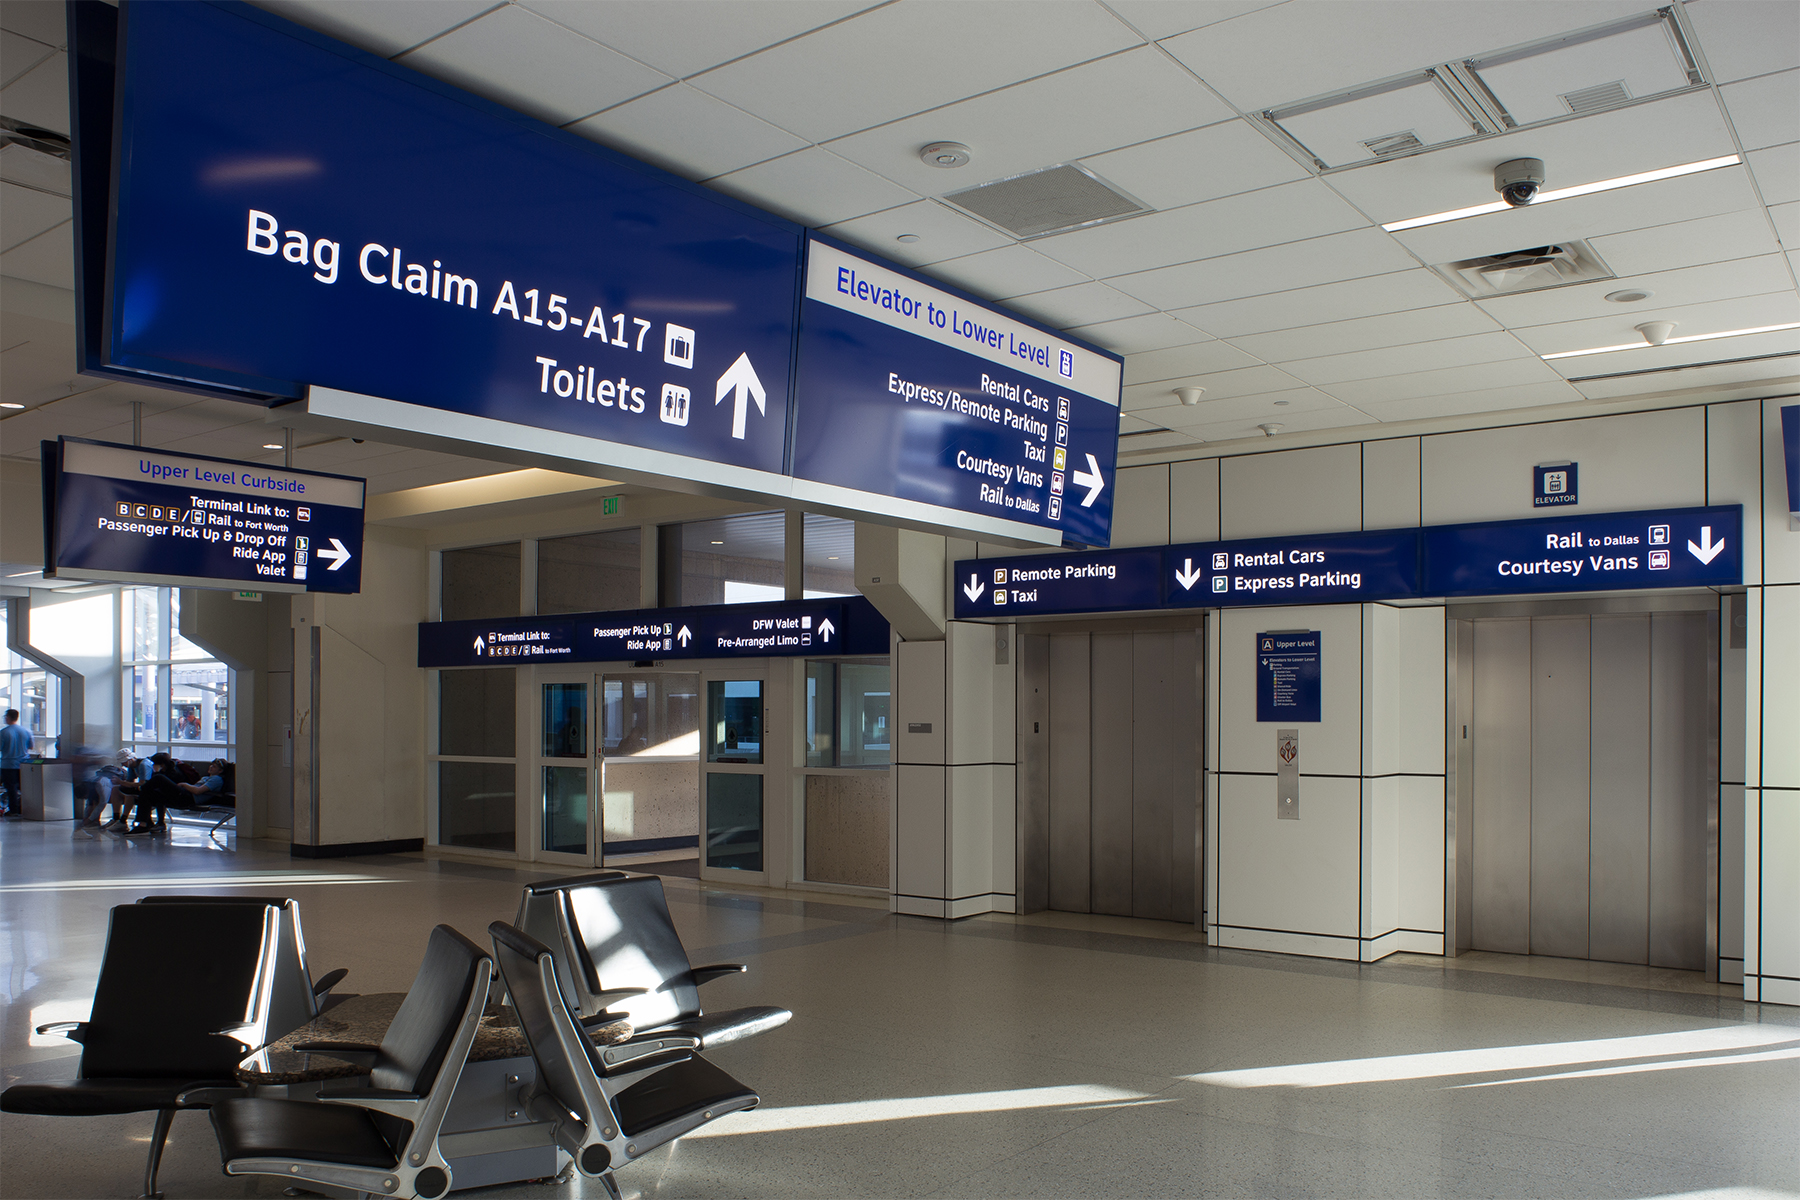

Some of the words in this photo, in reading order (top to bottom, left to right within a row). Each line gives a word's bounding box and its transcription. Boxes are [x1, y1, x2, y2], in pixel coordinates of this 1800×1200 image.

[246, 209, 341, 285] Bag
[359, 242, 479, 310] Claim
[491, 280, 652, 353] A15-A17
[837, 266, 921, 320] Elevator
[927, 302, 946, 328] to
[952, 310, 1004, 349] Lower
[1009, 332, 1050, 369] Level
[536, 355, 646, 414] Toilets
[981, 373, 1020, 403] Rental
[1023, 389, 1049, 413] Cars
[888, 372, 1000, 424] Express/Remote
[1004, 408, 1048, 443] Parking
[1024, 440, 1046, 464] Taxi
[139, 459, 189, 481] Upper
[195, 467, 236, 485] Level
[241, 474, 306, 494] Curbside
[956, 450, 1013, 485] Courtesy
[1016, 464, 1043, 488] Vans
[190, 496, 244, 513] Terminal
[247, 502, 271, 516] Link
[274, 505, 290, 518] to:
[603, 497, 619, 515] EXIT
[980, 483, 1004, 507] Rail
[1005, 493, 1014, 508] to
[1015, 497, 1040, 514] Dallas
[1535, 494, 1576, 505] ELEVATOR
[98, 518, 169, 538] Passenger
[172, 525, 200, 539] Pick
[203, 527, 221, 542] Up
[223, 530, 233, 542] &
[235, 531, 265, 547] Drop
[267, 534, 287, 547] Off
[209, 513, 232, 527] Rail
[234, 518, 244, 528] to
[245, 520, 263, 530] Fort
[263, 522, 289, 533] Worth
[1546, 531, 1583, 550] Rail
[1588, 537, 1601, 547] to
[1604, 535, 1640, 547] Dallas
[233, 547, 260, 560] Ride
[262, 549, 286, 564] App
[1234, 551, 1284, 568] Rental
[1289, 550, 1325, 565] Cars
[1498, 556, 1584, 576] Courtesy
[1590, 554, 1639, 572] Vans
[256, 563, 286, 577] Valet
[1012, 568, 1061, 583] Remote
[1064, 563, 1117, 581] Parking
[1234, 576, 1294, 593] Express
[1299, 571, 1361, 590] Parking
[1011, 589, 1038, 603] Taxi
[594, 627, 631, 639] Passenger
[632, 626, 649, 636] Pick
[650, 625, 662, 637] Up
[753, 619, 774, 630] DFW
[775, 618, 799, 629] Valet
[498, 632, 525, 642] Terminal
[527, 631, 540, 641] Link
[541, 631, 550, 640] to:
[627, 641, 643, 650] Ride
[645, 640, 661, 651] App
[717, 636, 775, 649] Pre-Arranged
[777, 635, 799, 646] Limo
[1276, 641, 1296, 649] Upper
[531, 645, 544, 654] Rail
